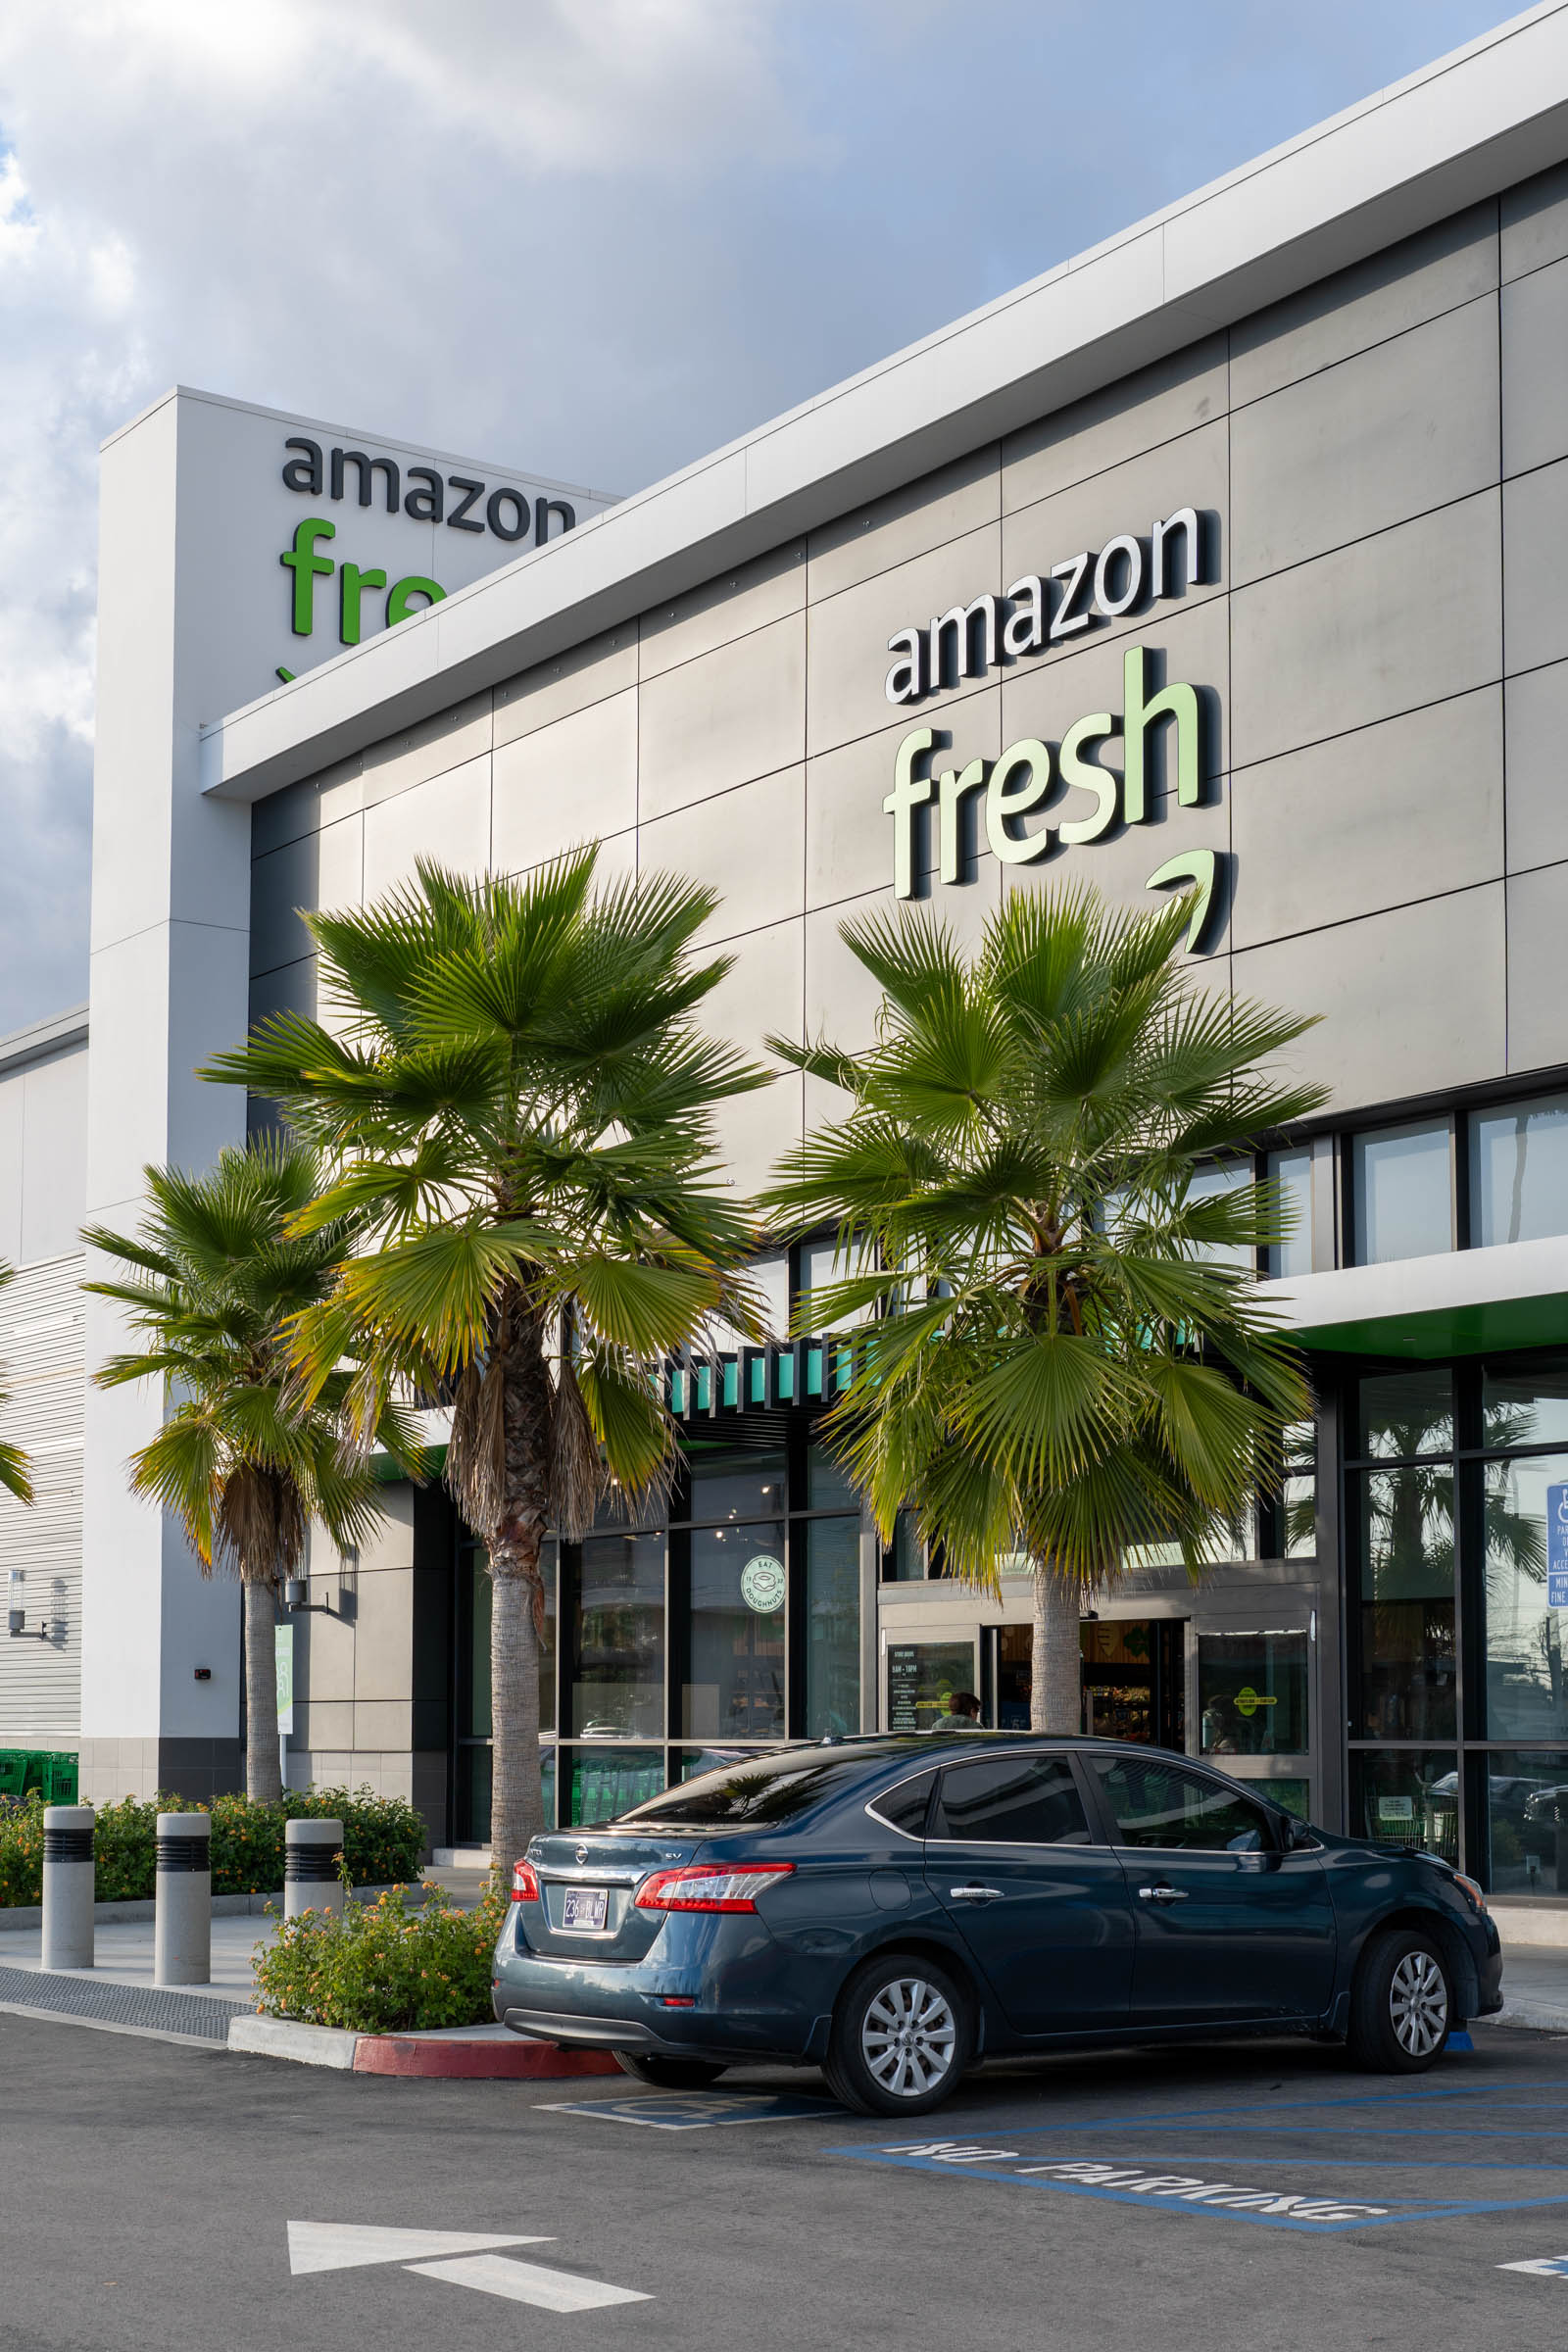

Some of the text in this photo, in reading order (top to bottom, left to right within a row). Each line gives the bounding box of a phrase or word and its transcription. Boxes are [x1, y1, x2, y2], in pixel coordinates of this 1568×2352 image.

[281, 436, 576, 547] amazon
[884, 506, 1209, 705] amazon
[882, 645, 1209, 901] fresh
[746, 1588, 782, 1608] DOUGHNUTS
[1550, 1591, 1566, 1603] FINE
[565, 1897, 580, 1918] 236
[881, 2142, 1389, 2221] NO PARKING
